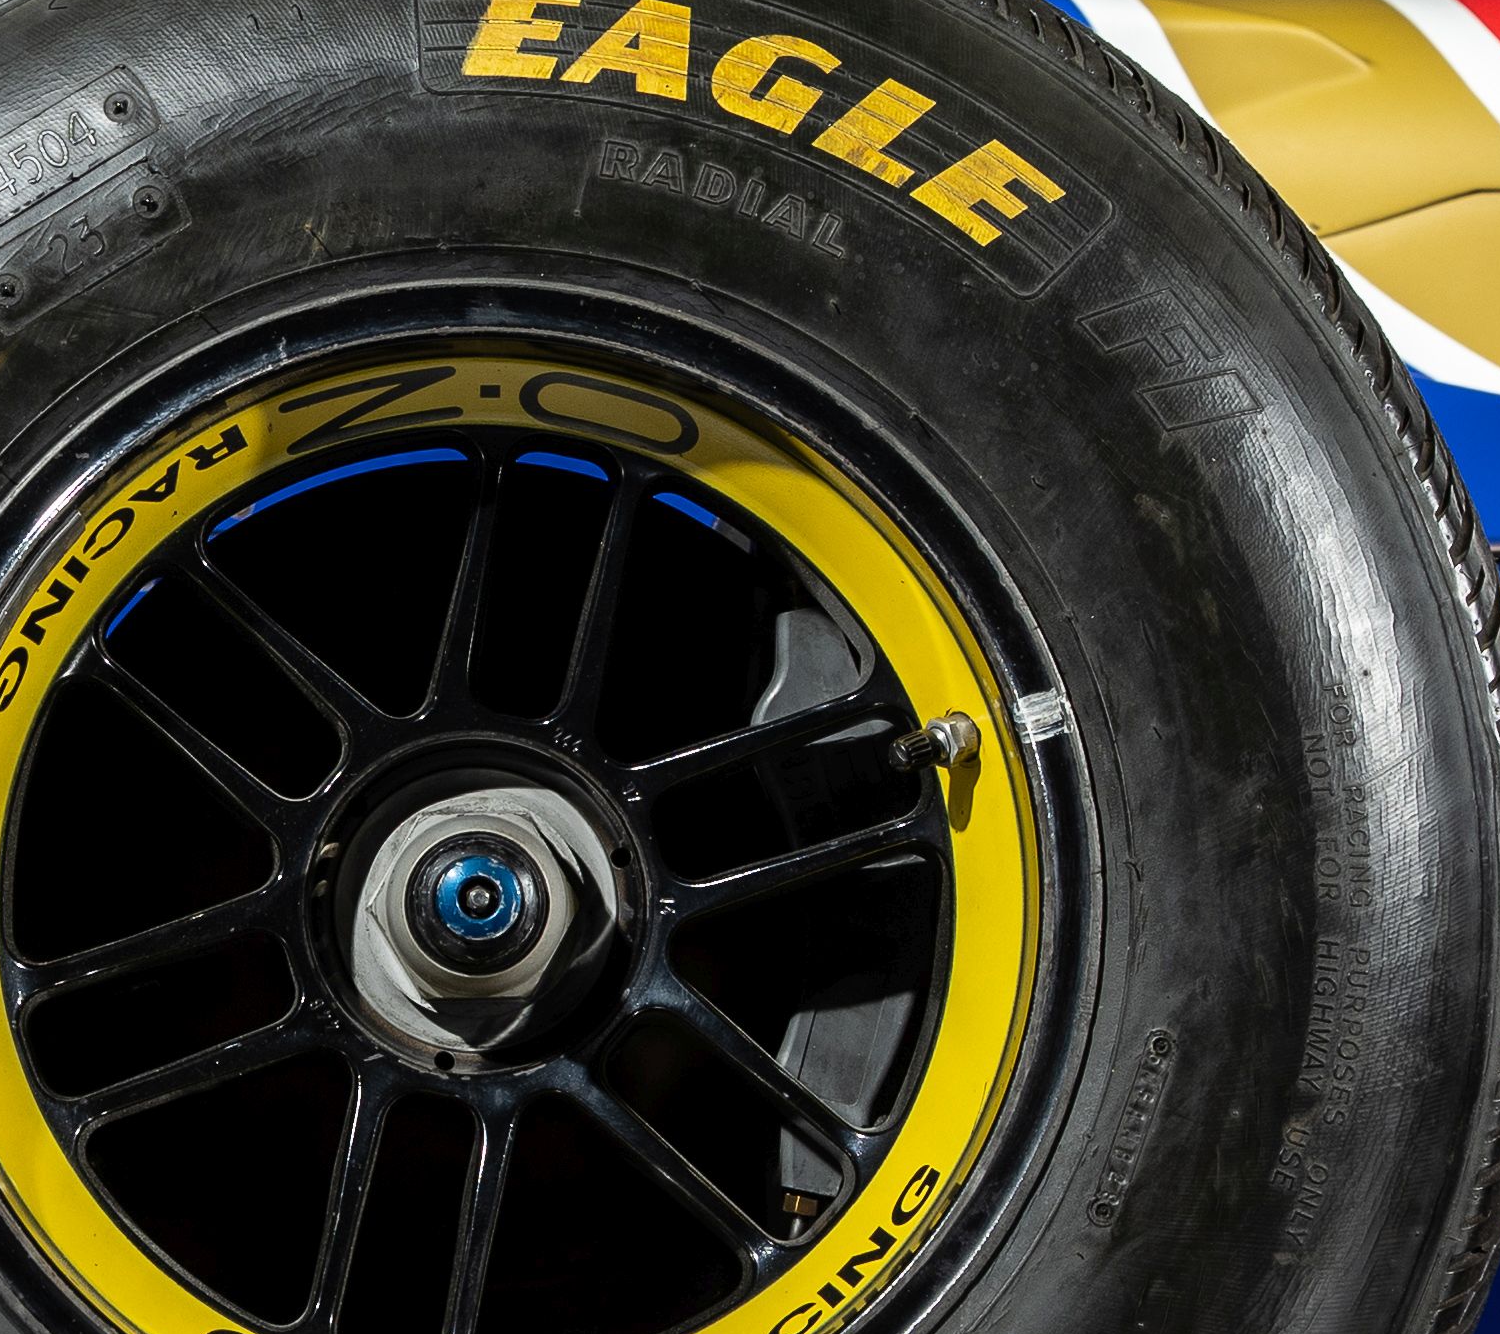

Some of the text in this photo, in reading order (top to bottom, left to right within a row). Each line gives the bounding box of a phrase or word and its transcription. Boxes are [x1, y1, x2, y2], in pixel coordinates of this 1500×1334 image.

[49, 215, 106, 277] 23
[600, 138, 846, 260] RADIAL
[1270, 733, 1341, 1192] NOT FOR HIGHWAY USE
[1285, 683, 1373, 1247] FOR RACING PURPOSES ONLY
